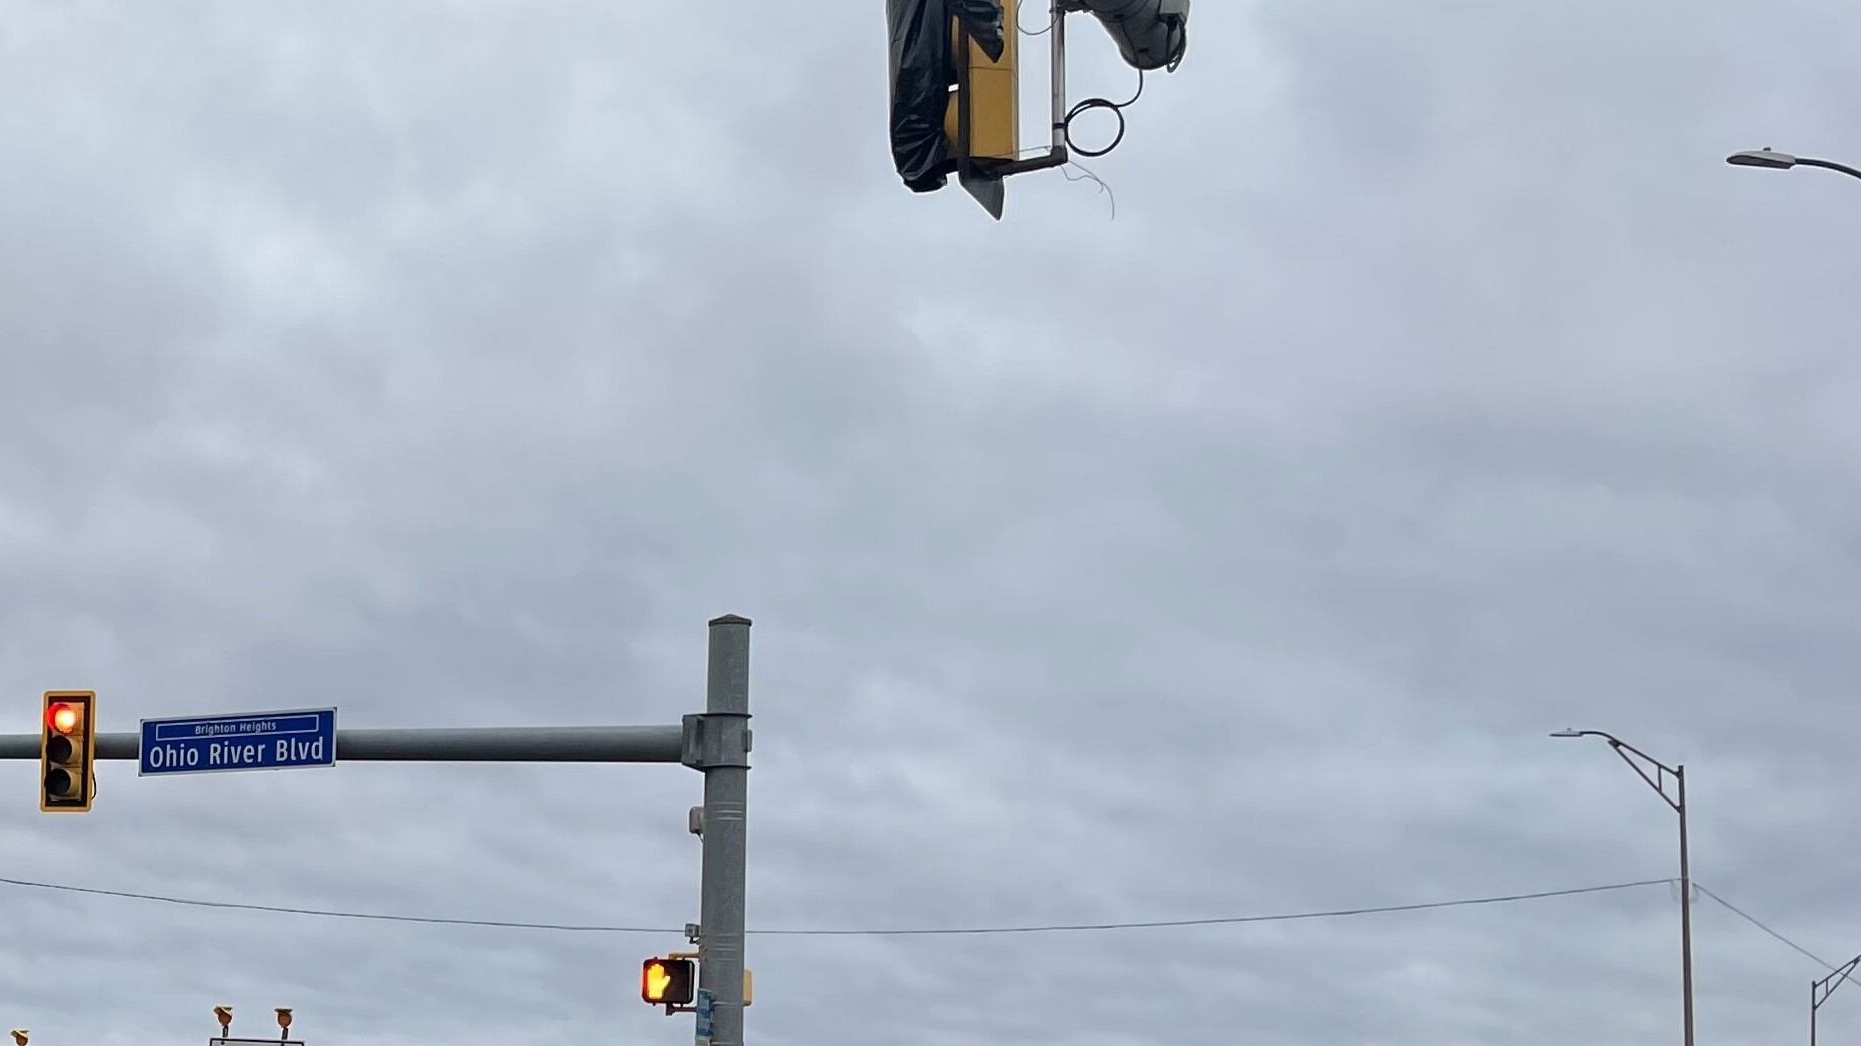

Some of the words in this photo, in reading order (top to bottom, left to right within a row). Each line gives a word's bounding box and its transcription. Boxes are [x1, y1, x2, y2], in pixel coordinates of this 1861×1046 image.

[195, 721, 236, 736] Brighton
[239, 721, 277, 734] Heights
[149, 743, 199, 768] Ohio
[209, 740, 266, 765] River
[276, 736, 324, 762] Blvd
